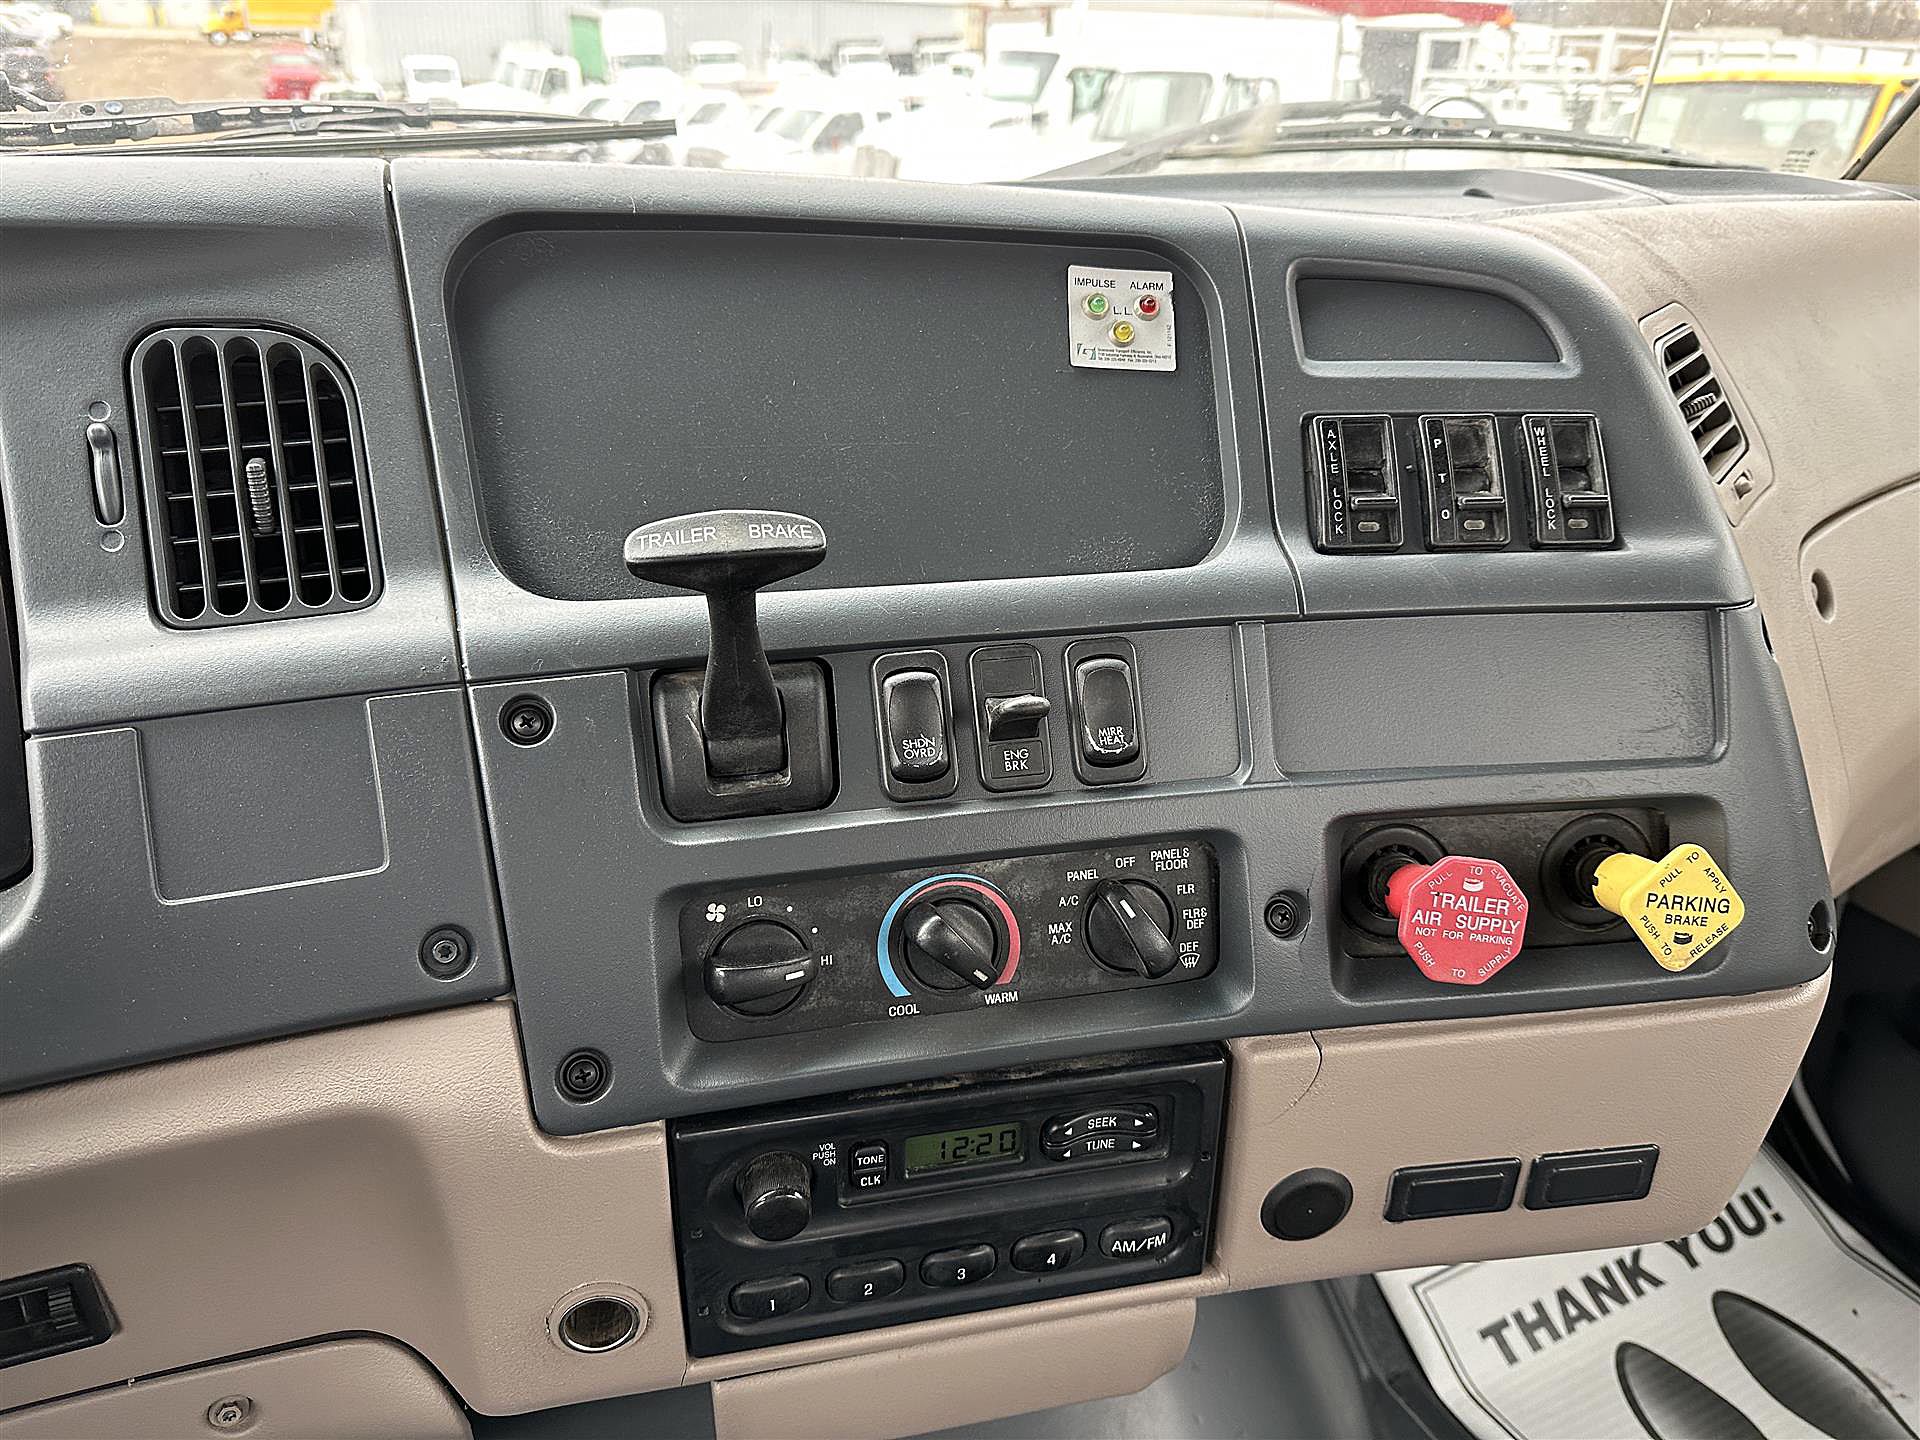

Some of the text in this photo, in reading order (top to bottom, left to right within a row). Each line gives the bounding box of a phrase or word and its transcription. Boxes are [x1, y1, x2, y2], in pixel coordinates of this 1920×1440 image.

[1074, 277, 1117, 289] IMPULSE
[1129, 281, 1164, 291] ALARM
[1327, 429, 1344, 535] AXLE LOCK
[1533, 426, 1557, 530] WHEEL LOCK
[636, 523, 814, 551] TRAILER BRAKE
[1098, 726, 1123, 738] MIRR
[902, 738, 936, 750] SHDN
[1099, 734, 1125, 746] HEAT
[903, 746, 936, 760] OVRD
[1003, 749, 1029, 761] ENG
[1004, 760, 1029, 772] BRK
[1115, 856, 1136, 868] OFF
[1155, 858, 1189, 872] FLOOR
[1066, 868, 1099, 881] PANEL
[1659, 851, 1727, 894] PULL TO APPLY
[1176, 884, 1195, 895] FLR
[1427, 866, 1526, 912] PULL TO EVACUATE
[747, 895, 763, 908] LO
[1058, 895, 1080, 907] A/C
[1430, 891, 1511, 916] TRAILER
[1646, 892, 1731, 914] PARKING
[1186, 918, 1205, 930] DEF
[1411, 909, 1521, 935] AIR SUPPLY
[1664, 913, 1709, 927] BRAKE
[1048, 921, 1073, 935] MAX
[1051, 933, 1072, 946] A/C
[1415, 926, 1513, 946] NOT FOR PARKING
[1639, 915, 1730, 958] PUSH TO RELEASE
[1179, 941, 1200, 953] DEF
[820, 954, 833, 966] HI
[1413, 941, 1512, 978] PUSH TO SUPPLY
[984, 990, 1019, 1005] WARM
[888, 1003, 920, 1017] COOL
[1087, 1116, 1117, 1130] SEEK
[818, 1142, 836, 1152] VOL
[939, 1129, 1017, 1160] 12:20
[1085, 1138, 1116, 1152] TUNE
[812, 1150, 836, 1161] PUSH
[823, 1157, 836, 1167] ON
[856, 1154, 885, 1167] TONE
[860, 1174, 881, 1187] CLK
[1111, 1232, 1167, 1253] AM/FM
[1046, 1253, 1057, 1265] 4
[956, 1267, 966, 1280] 3
[863, 1282, 873, 1296] 2
[769, 1299, 776, 1312] 1
[1479, 1247, 1666, 1367] THANK
